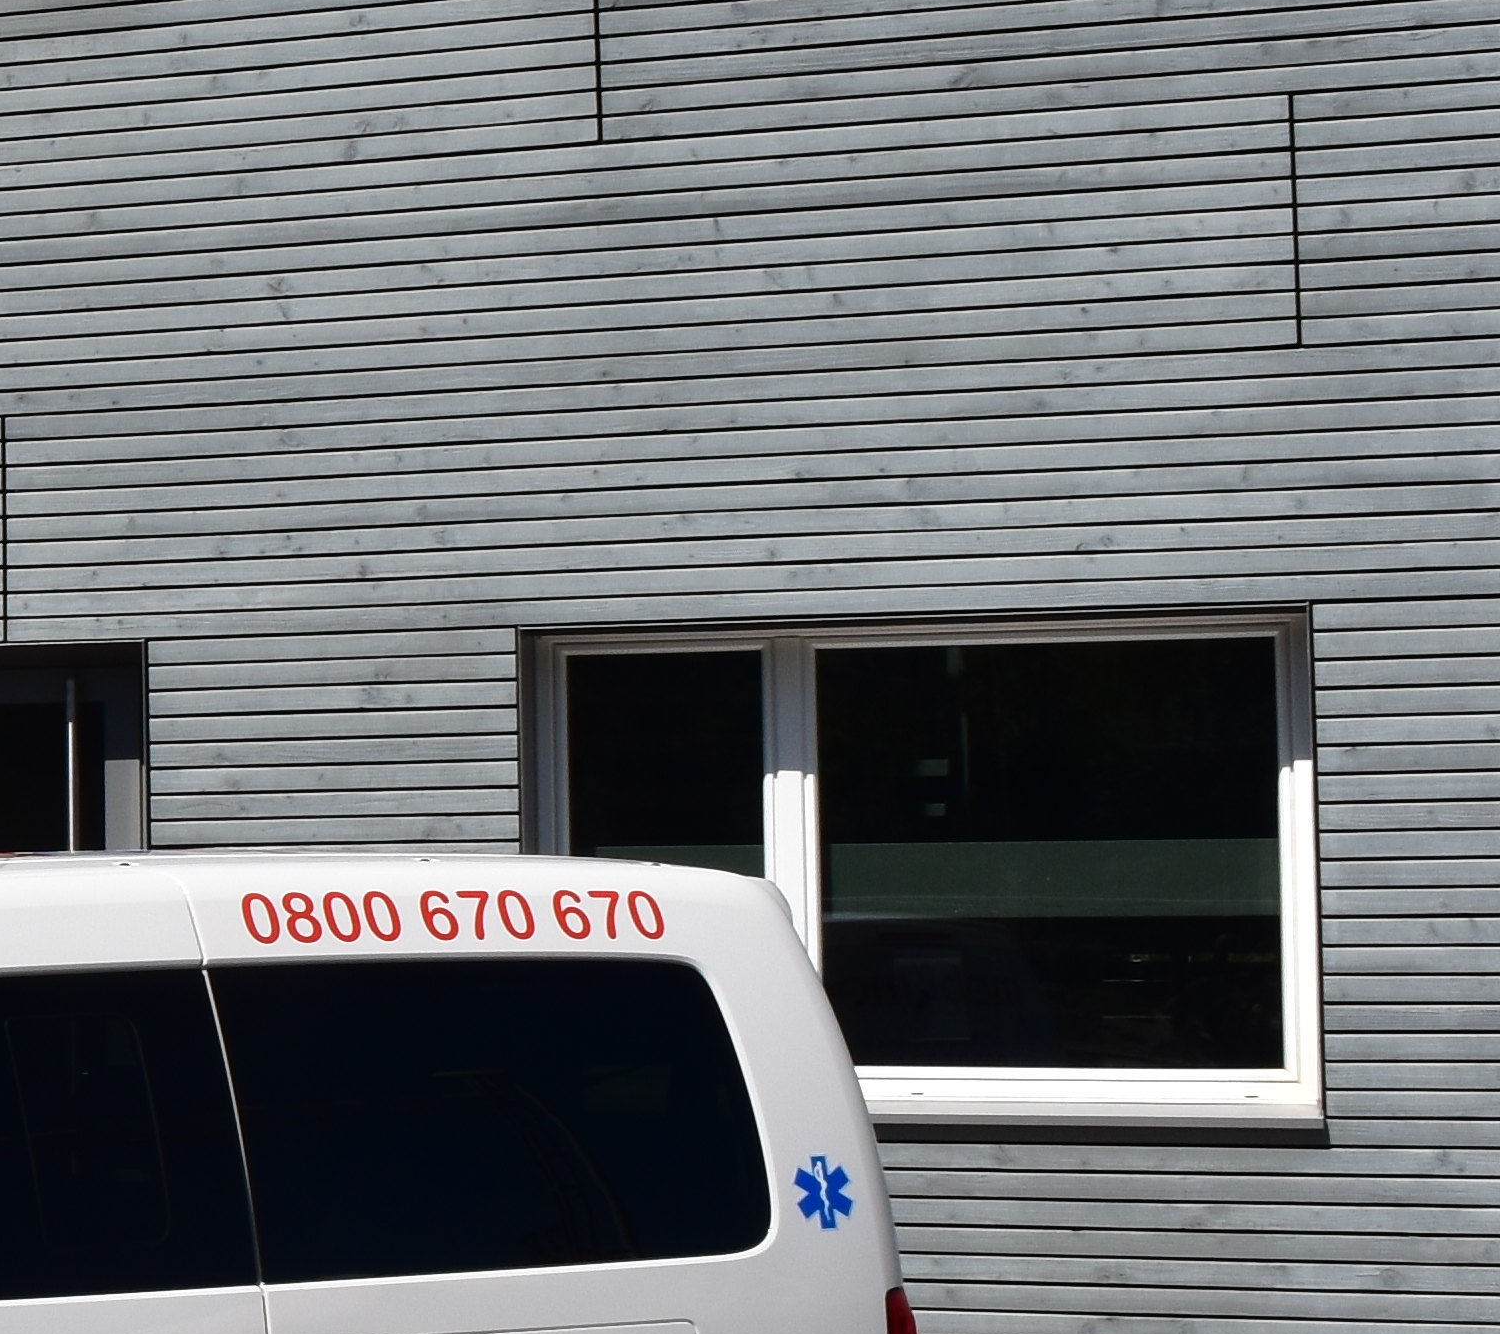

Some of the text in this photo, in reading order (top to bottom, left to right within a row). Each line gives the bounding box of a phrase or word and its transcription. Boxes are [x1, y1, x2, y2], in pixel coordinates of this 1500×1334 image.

[241, 888, 666, 945] 0800 670 670
